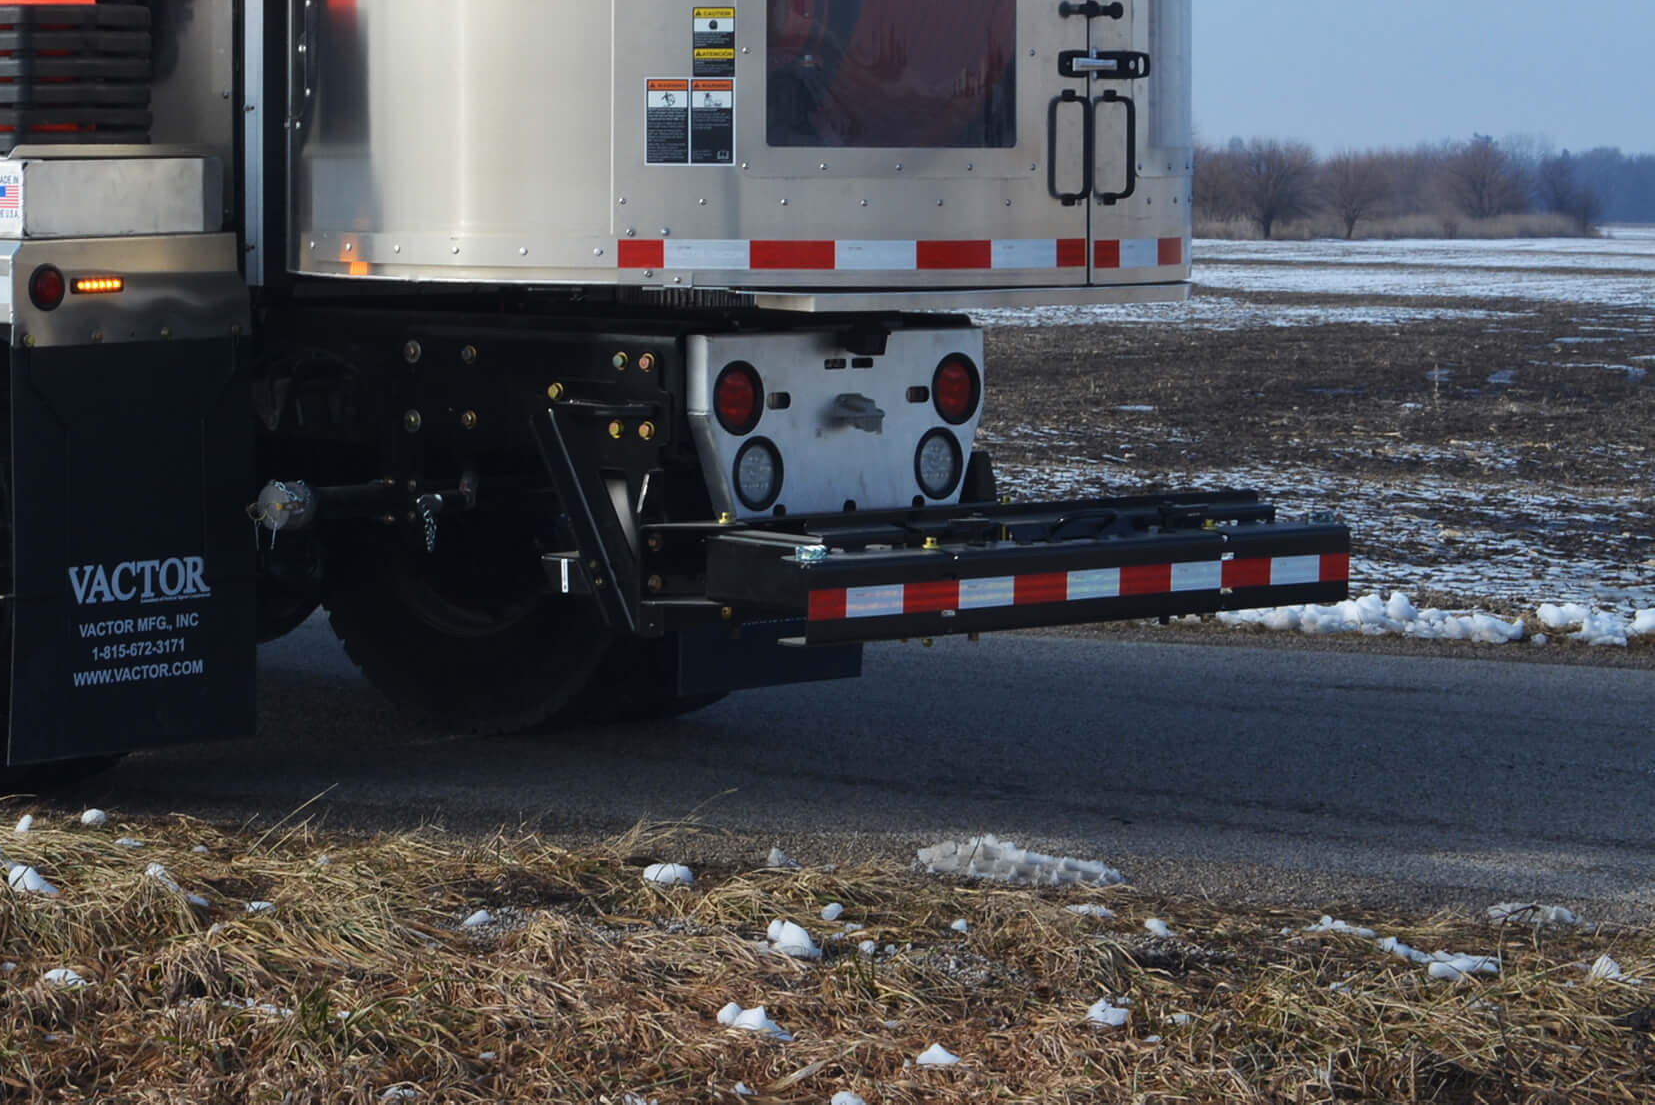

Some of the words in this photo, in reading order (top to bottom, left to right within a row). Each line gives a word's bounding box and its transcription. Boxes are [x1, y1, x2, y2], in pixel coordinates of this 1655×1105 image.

[13, 175, 19, 184] IN
[68, 555, 212, 605] VACTOR
[79, 618, 135, 639] VACTOR
[175, 612, 200, 628] INC
[91, 637, 186, 662] 1-815-672-3171
[72, 658, 204, 688] WWW.VACTOR.COM
